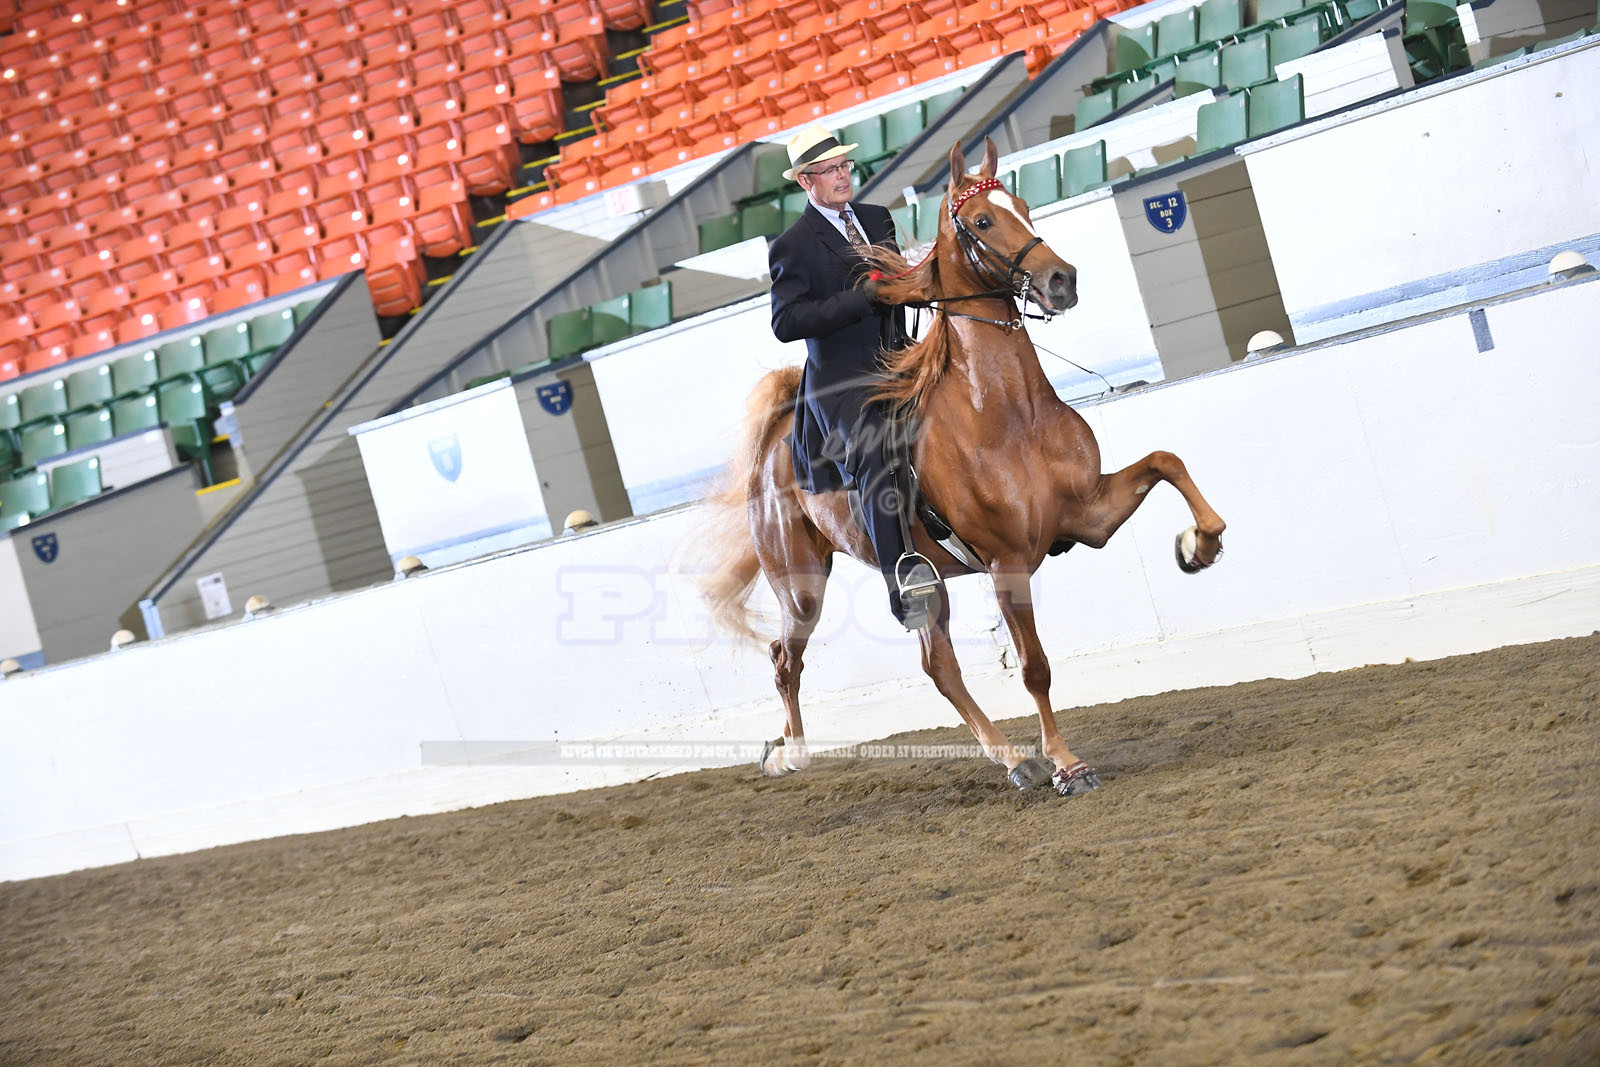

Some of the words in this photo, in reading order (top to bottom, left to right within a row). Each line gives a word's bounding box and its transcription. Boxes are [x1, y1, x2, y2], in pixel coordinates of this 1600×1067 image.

[1149, 201, 1163, 209] SEC.
[1168, 197, 1178, 207] 12
[1160, 209, 1173, 218] BOX
[1166, 217, 1173, 228] 3
